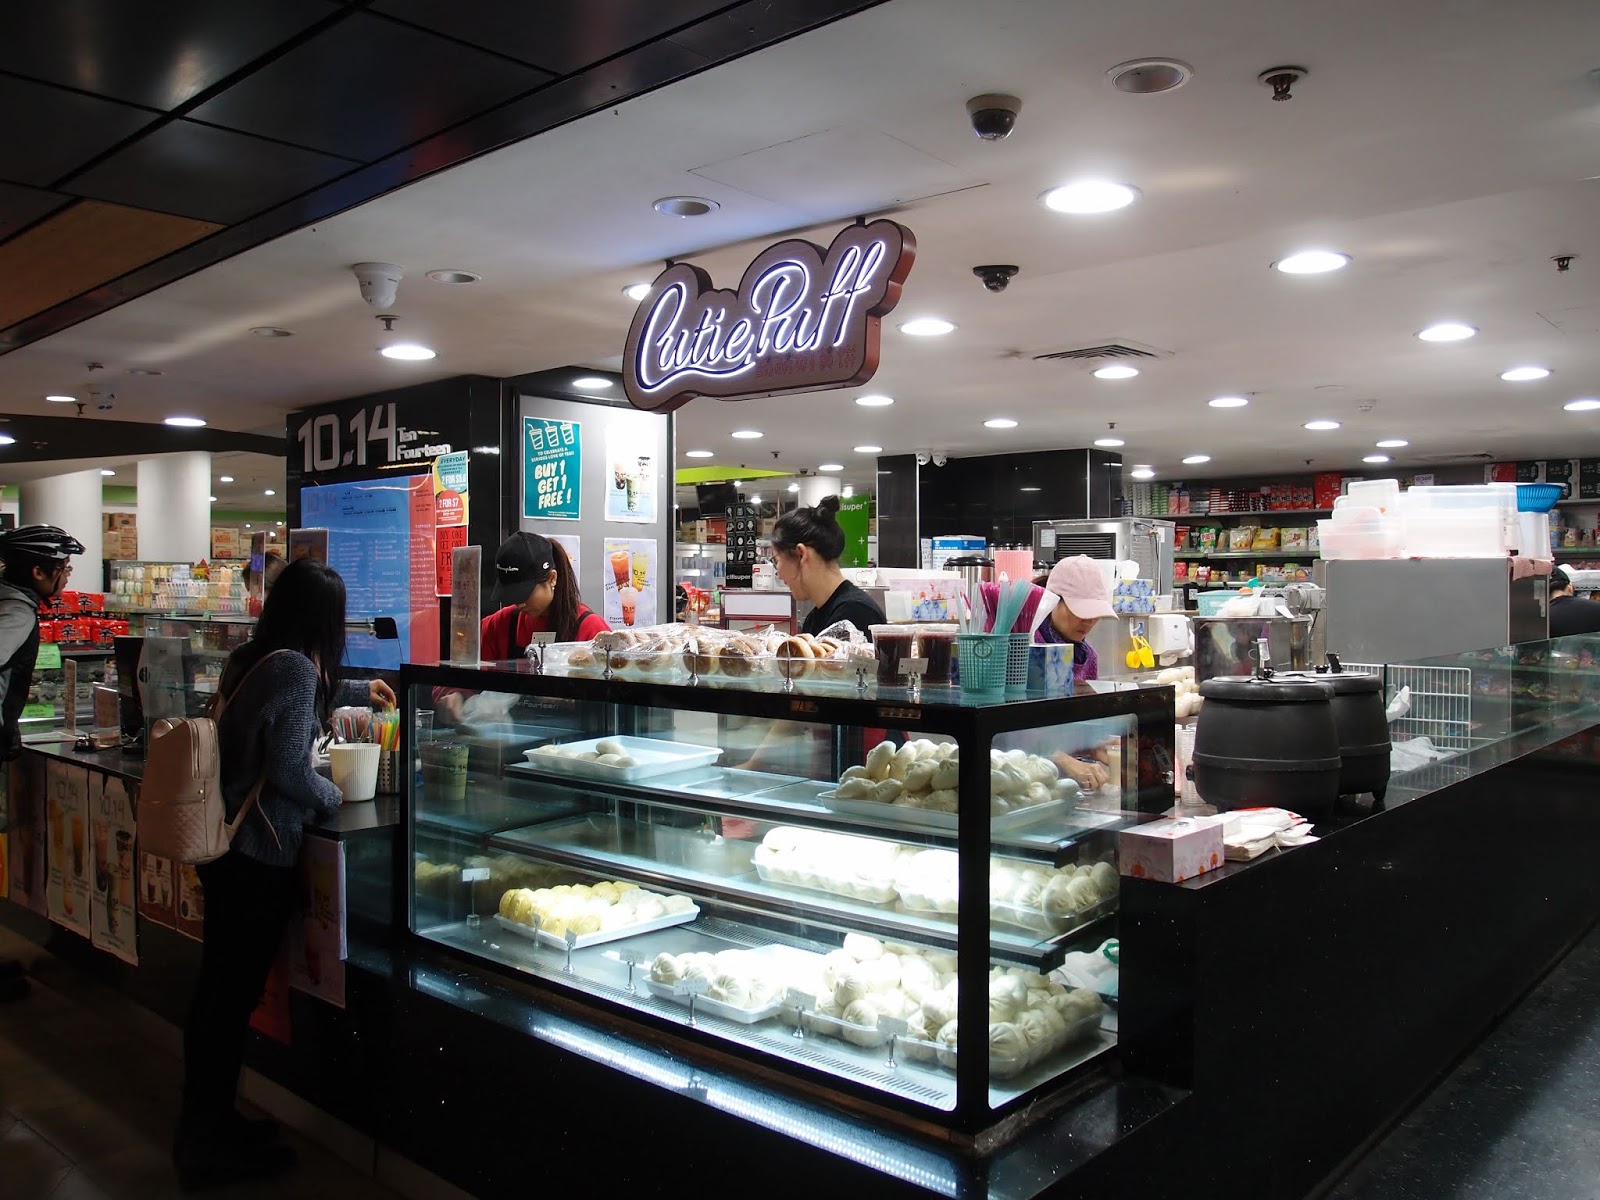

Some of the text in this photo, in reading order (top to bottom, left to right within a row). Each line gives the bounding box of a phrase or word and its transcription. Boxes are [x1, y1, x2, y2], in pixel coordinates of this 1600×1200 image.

[635, 240, 886, 393] Cutie Puff
[298, 402, 397, 473] 10.14
[397, 427, 418, 443] Ten
[397, 443, 451, 461] Fourteen
[440, 455, 466, 464] EVERYDAY
[534, 459, 566, 480] BUY 1
[537, 474, 567, 494] GET 1
[538, 490, 564, 510] FREE
[440, 551, 452, 566] FR
